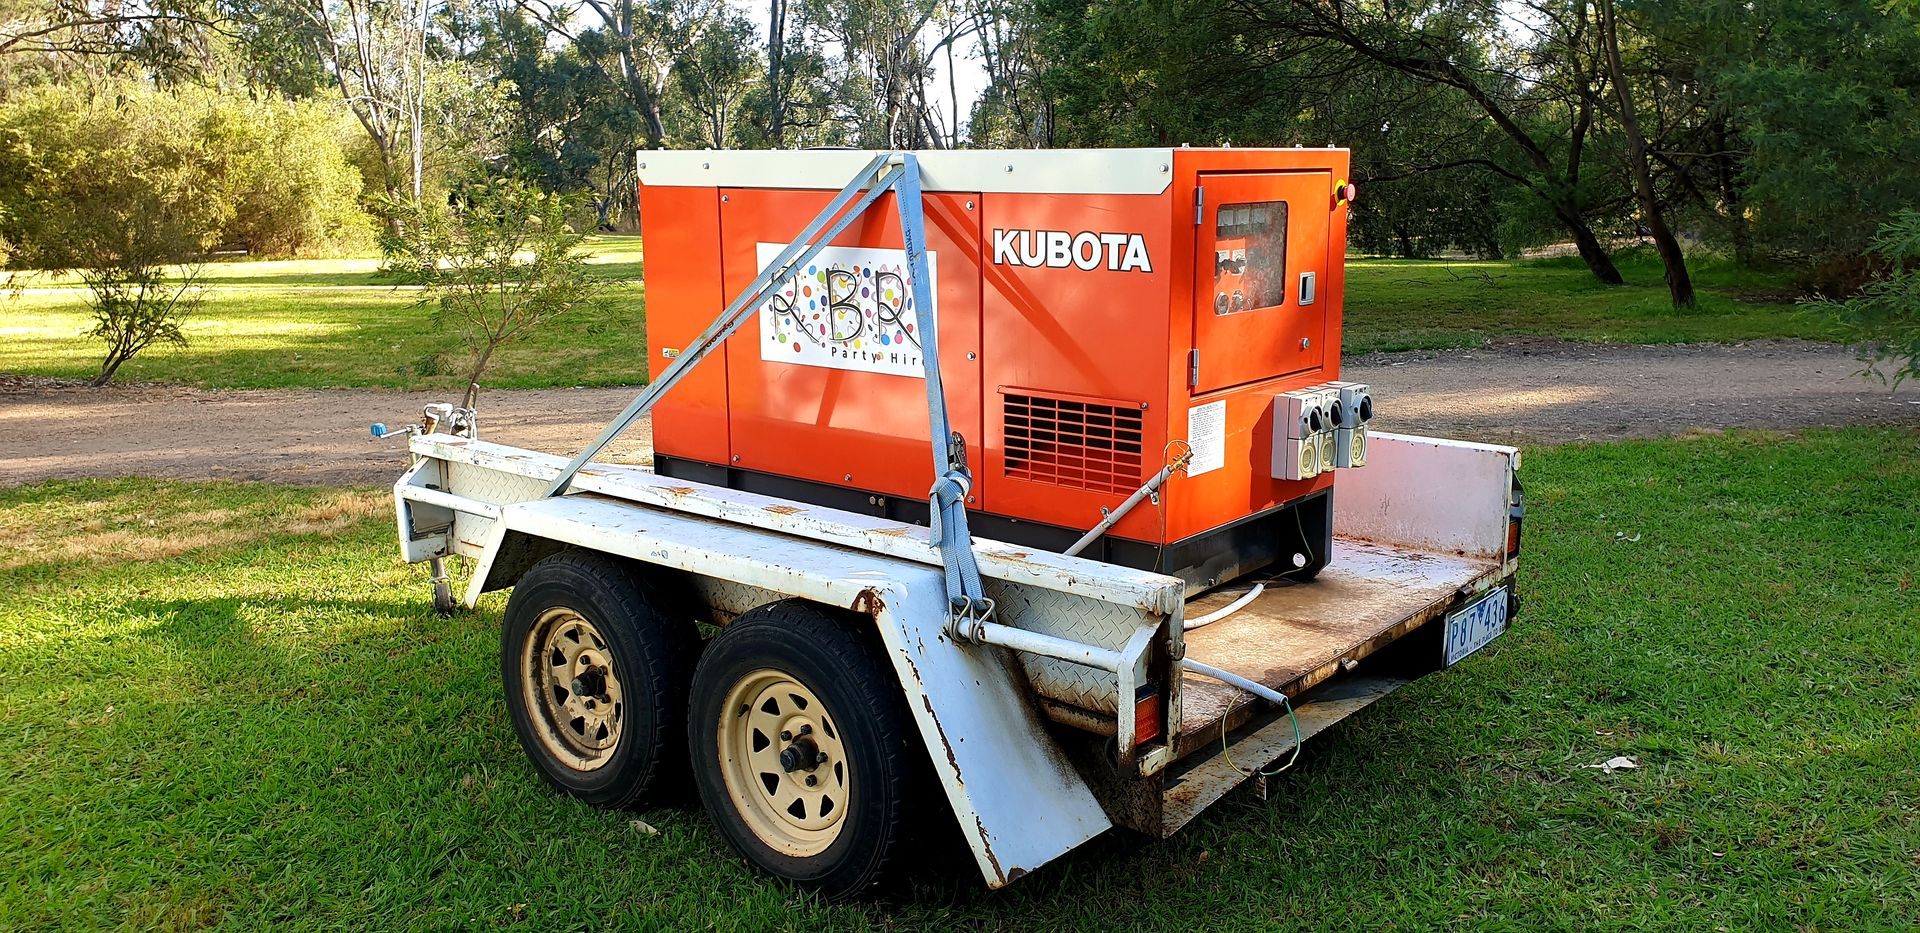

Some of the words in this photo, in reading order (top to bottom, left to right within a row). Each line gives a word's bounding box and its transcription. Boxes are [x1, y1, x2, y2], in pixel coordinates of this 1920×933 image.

[993, 228, 1153, 273] KUBOTA
[832, 347, 877, 363] Party
[891, 353, 924, 366] Hir
[1451, 612, 1476, 652] P87
[1484, 595, 1505, 632] 436
